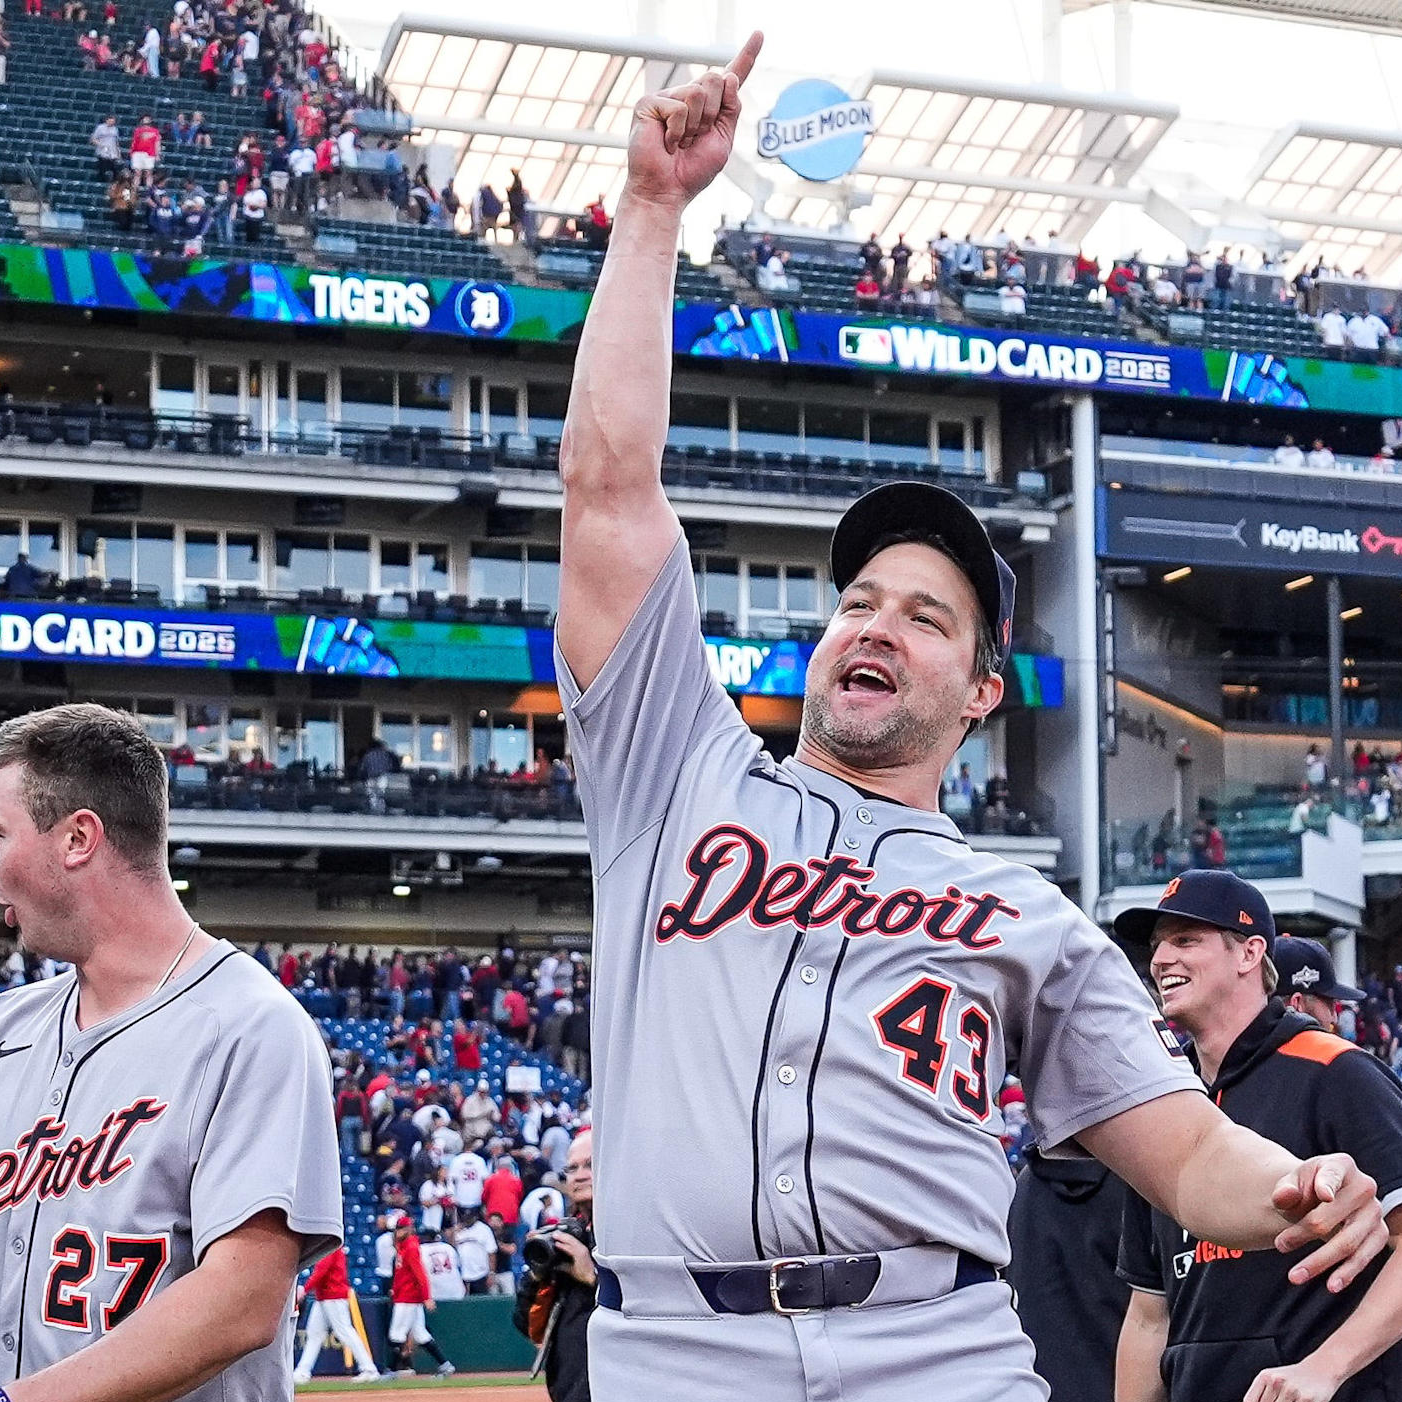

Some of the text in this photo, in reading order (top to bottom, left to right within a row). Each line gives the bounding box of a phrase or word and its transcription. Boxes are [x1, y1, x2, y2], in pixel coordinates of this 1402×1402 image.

[762, 106, 872, 151] BLUE MOON
[309, 274, 431, 328] TIGERS
[1105, 357, 1171, 381] 2025
[1261, 523, 1360, 553] KeyBank
[158, 630, 236, 653] 2025
[654, 821, 1023, 951] Detroit
[868, 972, 996, 1126] 43
[42, 1223, 171, 1333] 27
